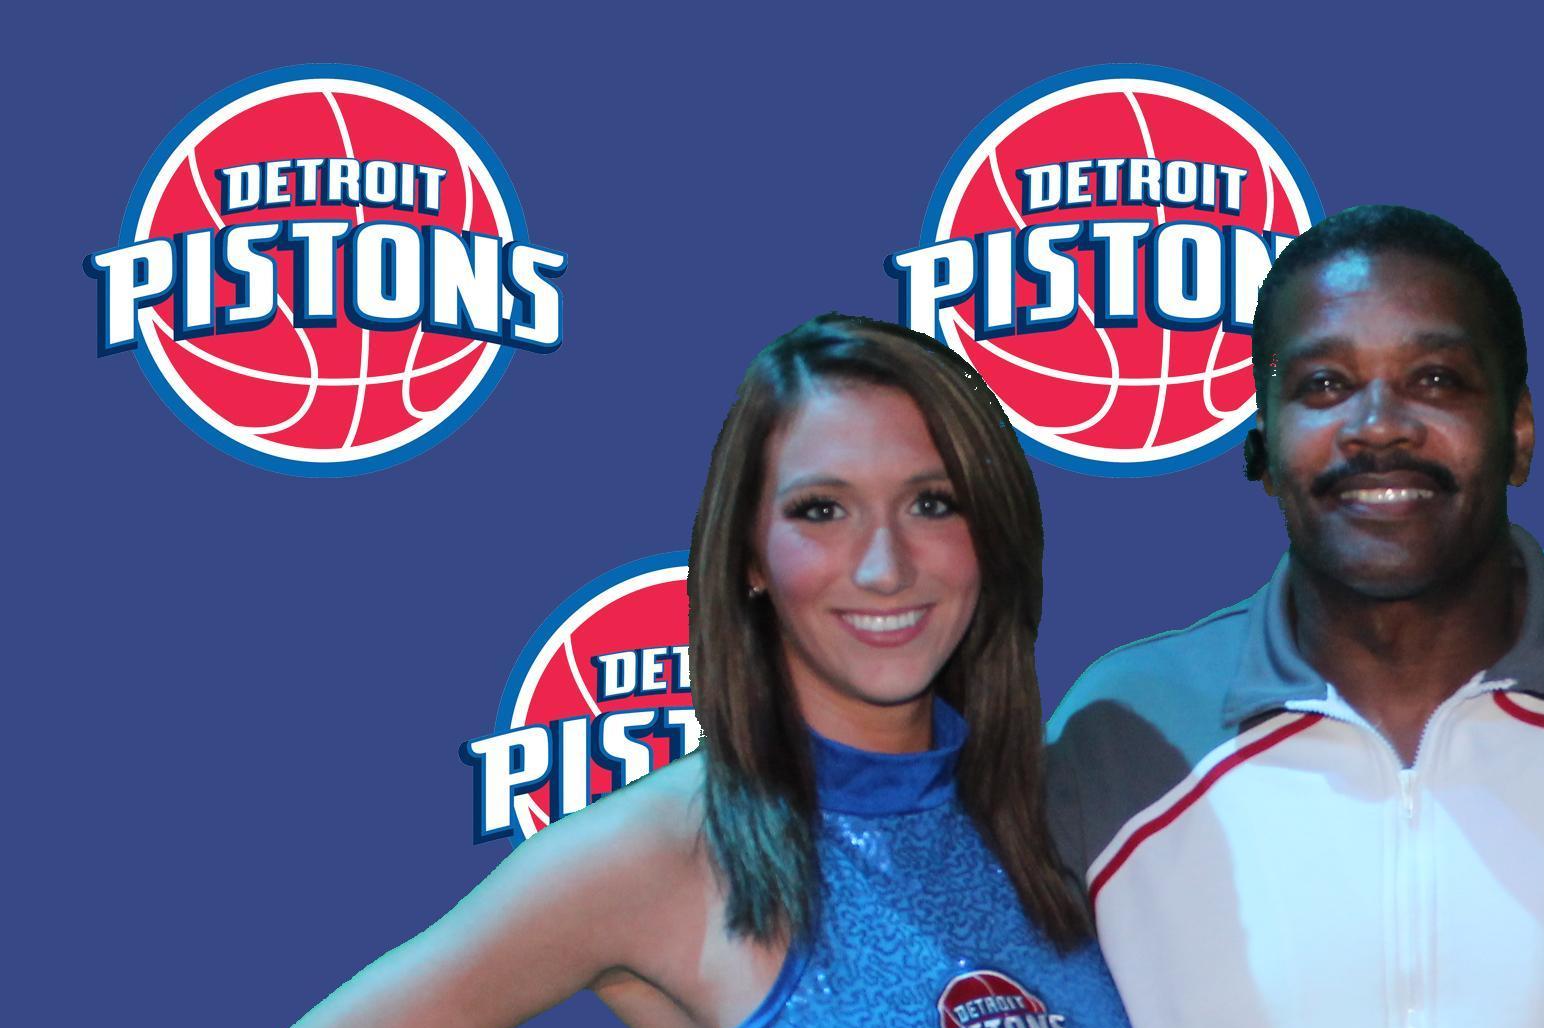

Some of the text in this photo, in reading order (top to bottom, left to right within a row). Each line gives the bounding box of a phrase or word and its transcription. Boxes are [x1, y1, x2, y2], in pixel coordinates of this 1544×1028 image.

[215, 157, 447, 215] DETROIT
[1016, 157, 1248, 215] DETROIT
[83, 220, 568, 358] PISTONS
[954, 996, 1025, 1024] DETROIT
